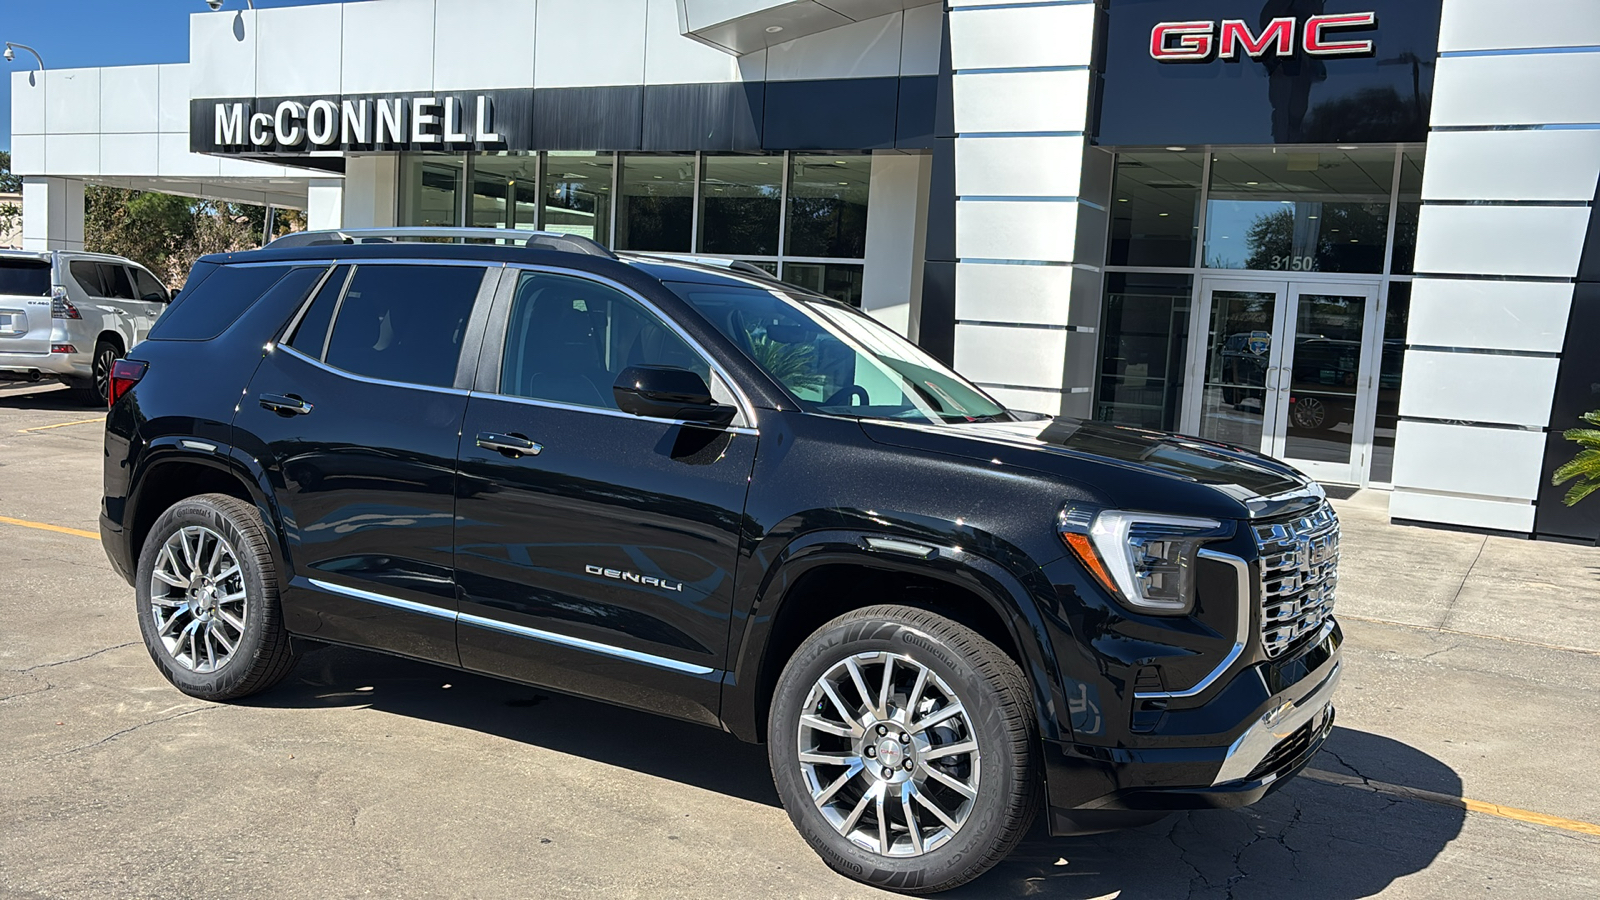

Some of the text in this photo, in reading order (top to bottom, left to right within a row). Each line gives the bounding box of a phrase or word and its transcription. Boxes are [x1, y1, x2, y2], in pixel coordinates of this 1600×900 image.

[1150, 12, 1376, 60] GMC
[1270, 255, 1313, 271] 3150
[585, 564, 683, 592] DENALI
[902, 632, 958, 672] Continental
